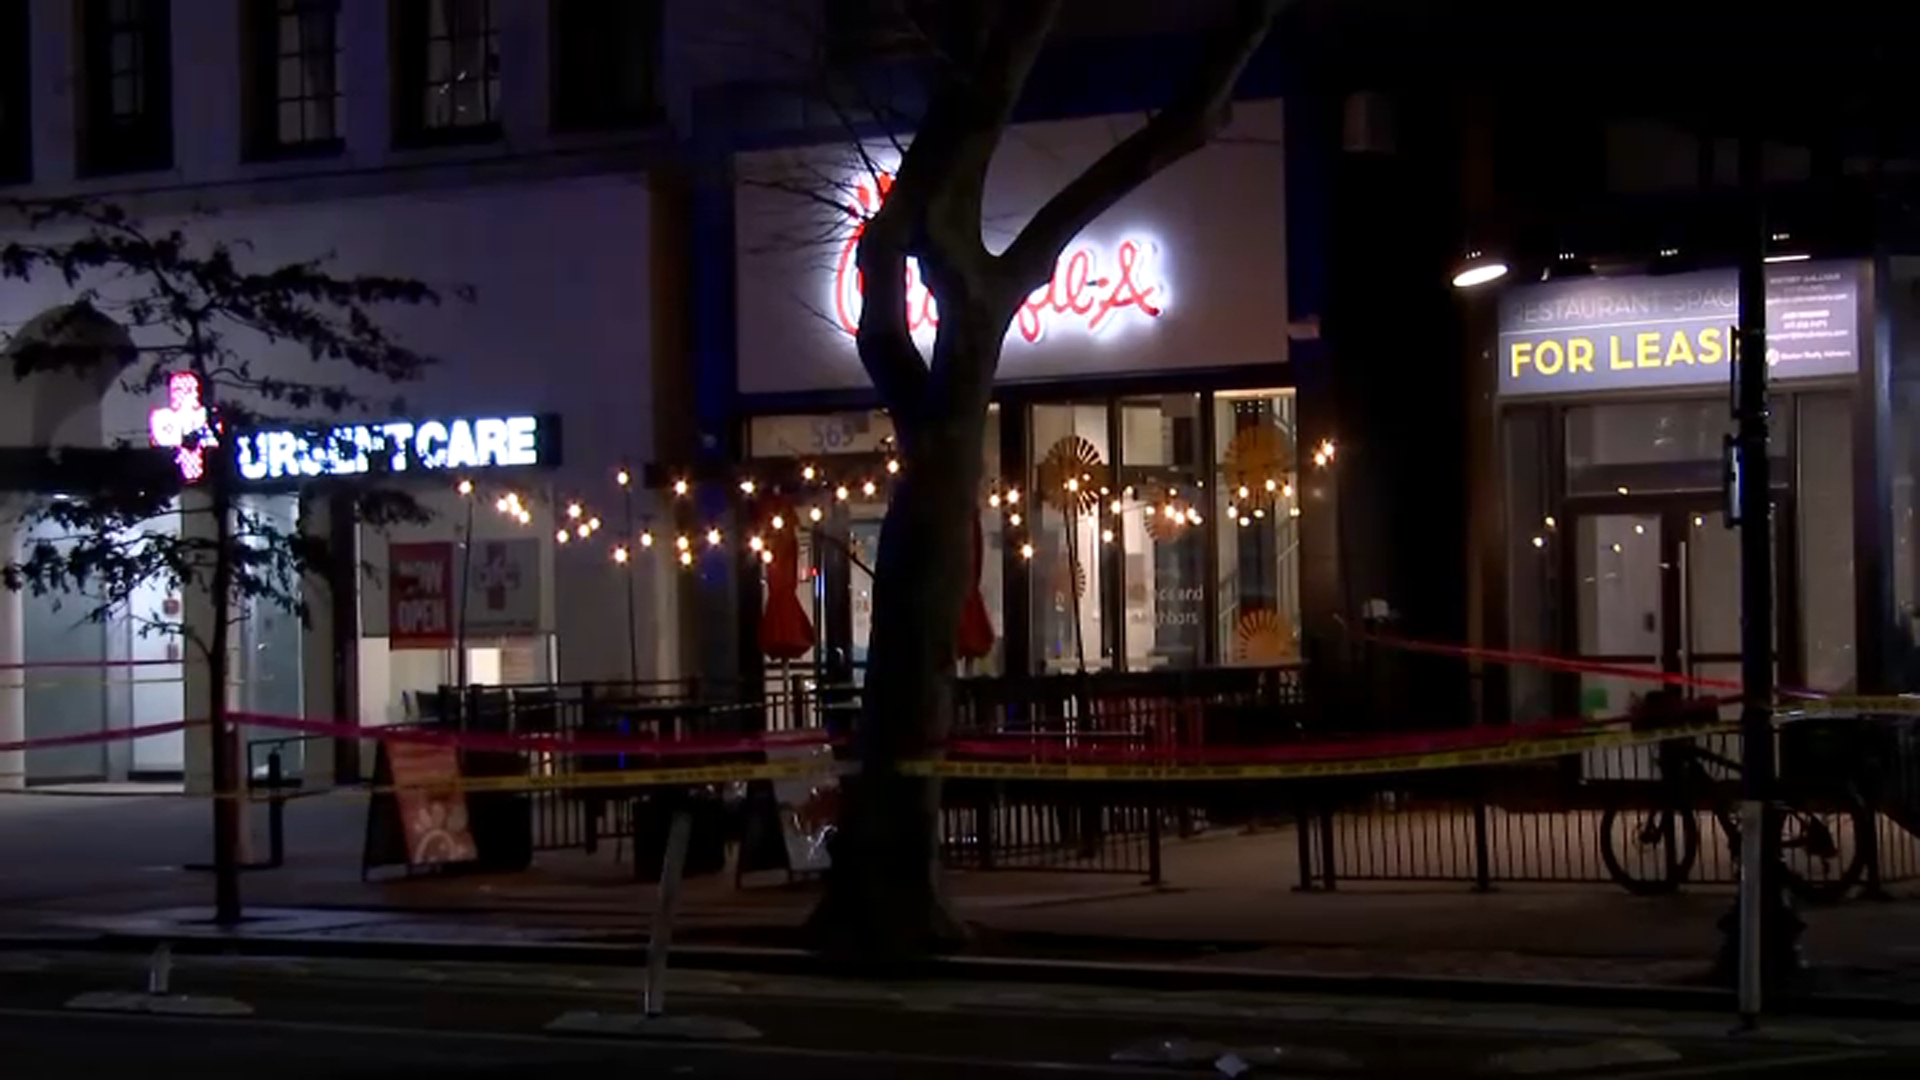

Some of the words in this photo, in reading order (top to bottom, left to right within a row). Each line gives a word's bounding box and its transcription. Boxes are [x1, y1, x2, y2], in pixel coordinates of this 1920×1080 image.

[1673, 286, 1739, 312] SPAC
[1510, 338, 1595, 378] FOR
[415, 416, 537, 468] CARE
